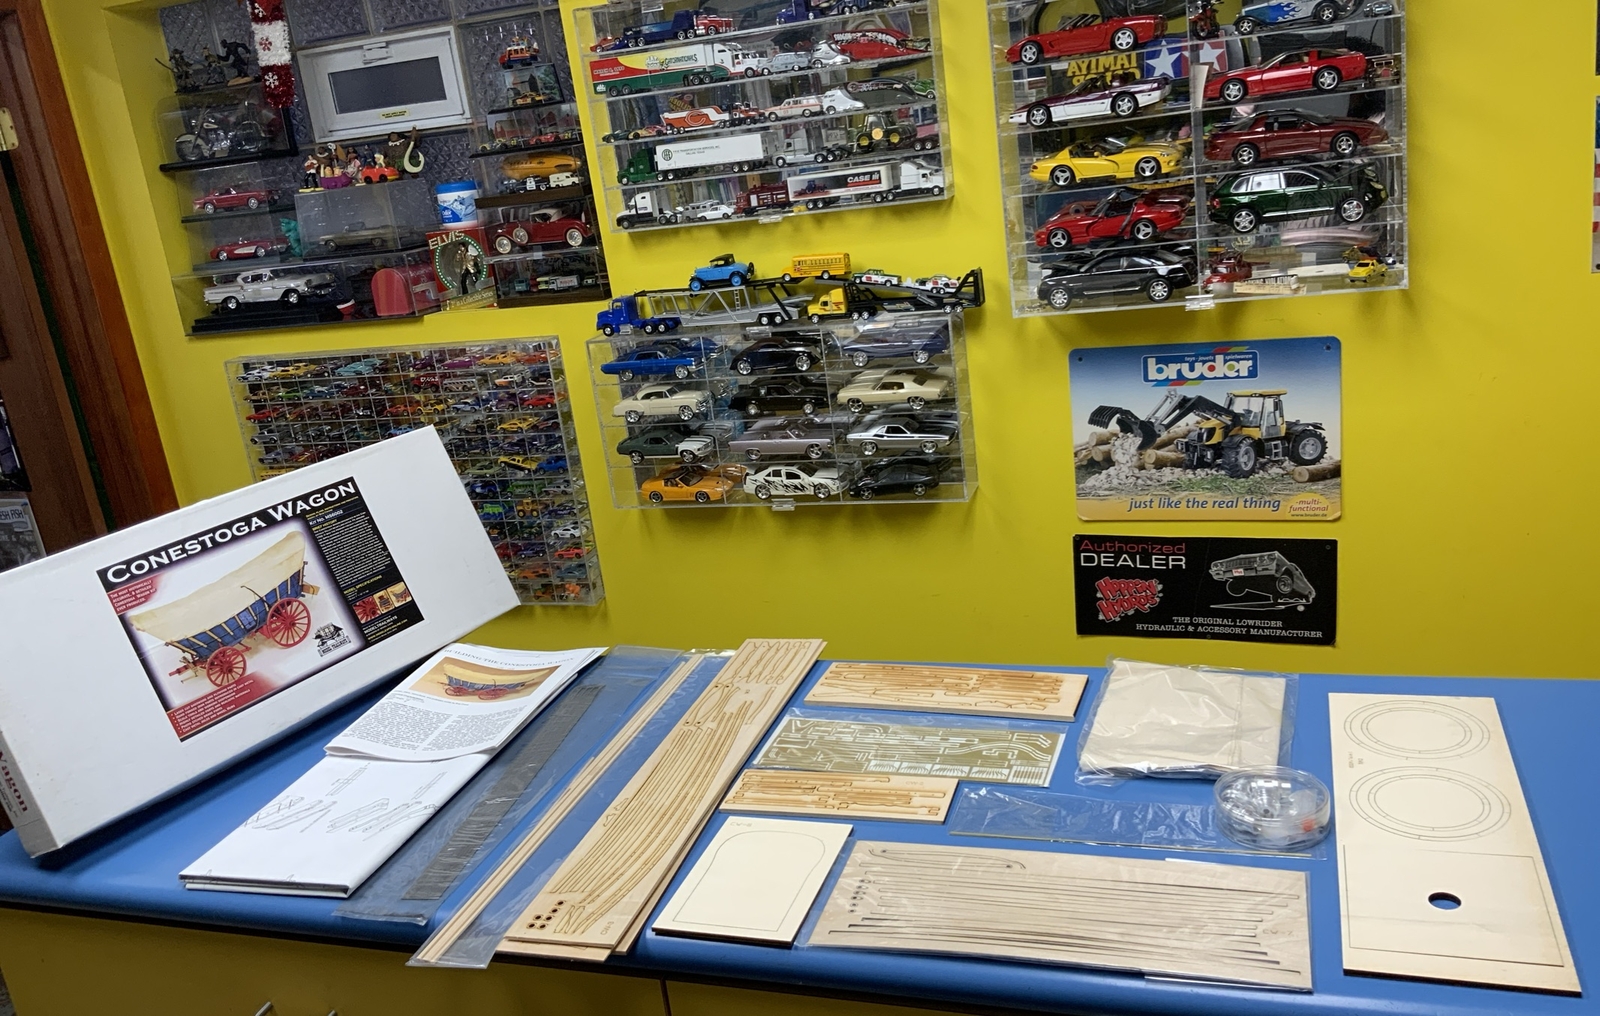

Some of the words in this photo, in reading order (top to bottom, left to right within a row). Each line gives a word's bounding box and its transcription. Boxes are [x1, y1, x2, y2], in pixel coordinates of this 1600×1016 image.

[847, 175, 870, 183] CASE
[429, 230, 464, 250] ELVIS
[1147, 355, 1252, 380] bruder
[1128, 498, 1154, 512] just
[1158, 497, 1180, 509] like
[1186, 498, 1206, 509] the
[1212, 497, 1238, 509] real
[1243, 497, 1280, 511] thing
[1288, 504, 1329, 513] functional
[107, 515, 268, 583] CONESTOGA
[267, 482, 356, 522] WAGON
[1080, 540, 1186, 553] Authorized
[1081, 553, 1186, 569] DEALER
[1193, 617, 1234, 625] ORIGINAL
[1136, 624, 1184, 632] HYDRAULIC
[1197, 626, 1247, 635] ACCESSORY
[1250, 628, 1322, 638] MANUFACTURER
